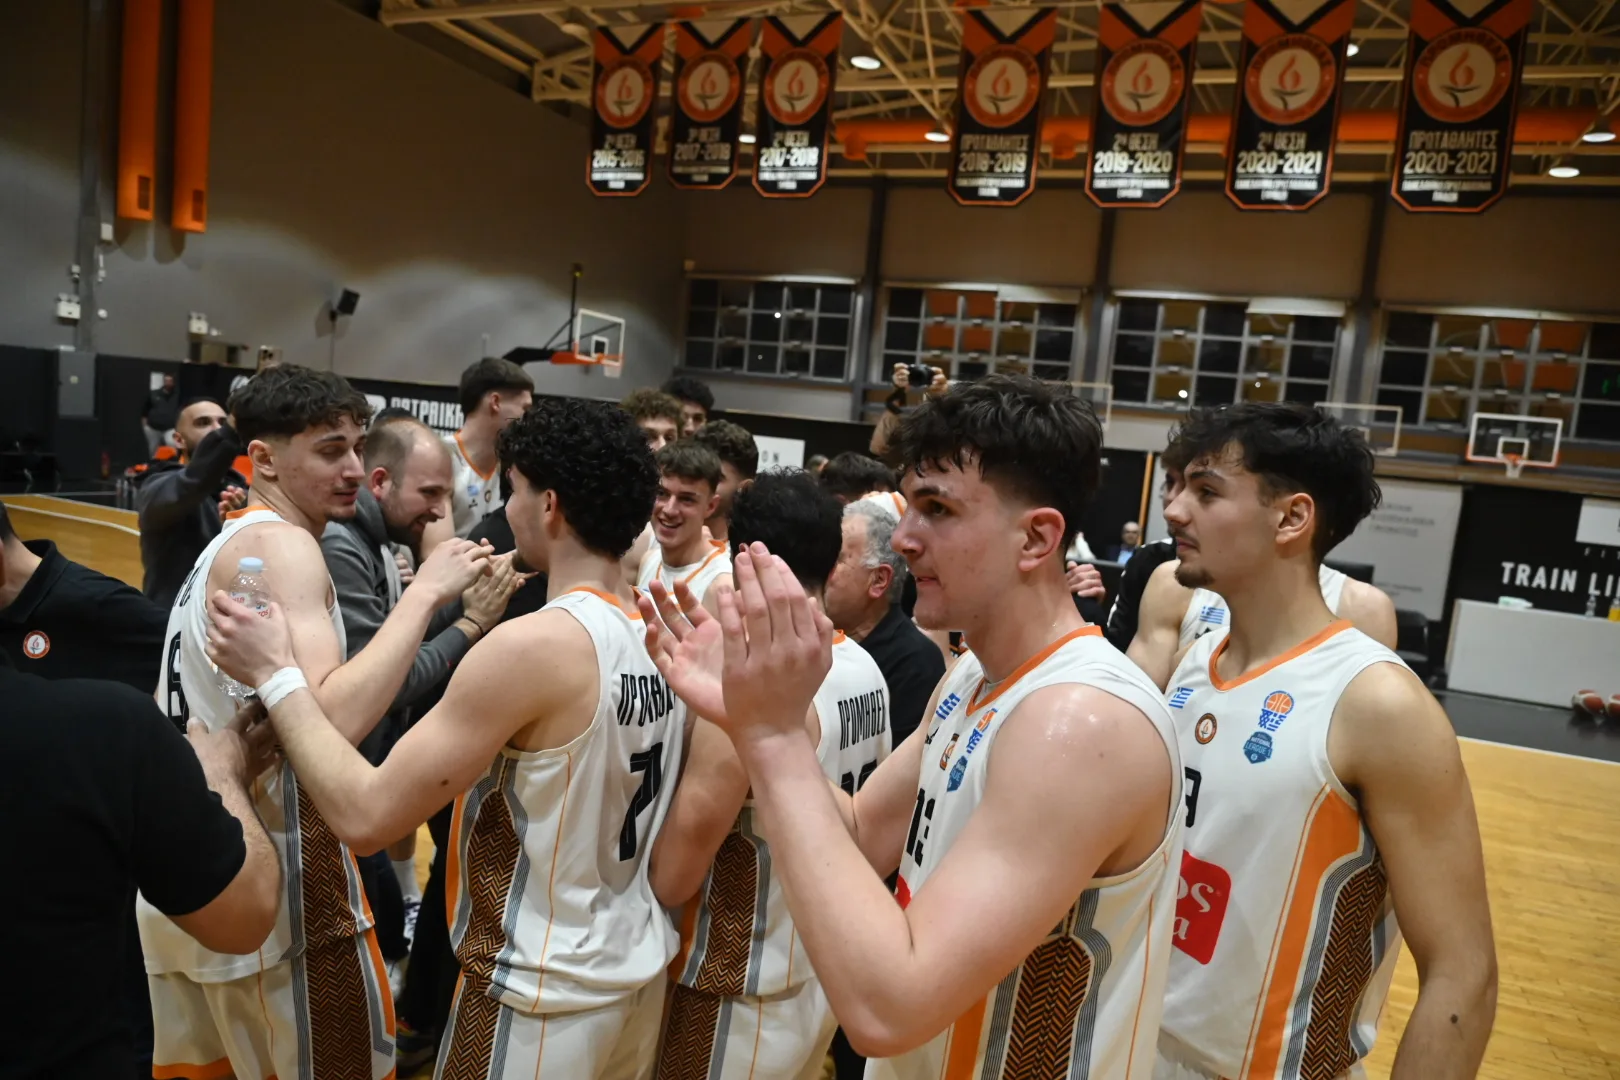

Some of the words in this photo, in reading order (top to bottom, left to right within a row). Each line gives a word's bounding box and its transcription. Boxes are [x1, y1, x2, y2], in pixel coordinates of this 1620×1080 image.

[1408, 130, 1499, 150] ΠΡΩΤΑΘΛΗΤΕΣ
[958, 152, 1027, 173] 2018-2019
[1094, 150, 1173, 173] 2019-2020
[1236, 151, 1323, 174] 2020-2021
[1402, 150, 1497, 174] 2020-2021
[1501, 561, 1578, 593] TRAIN
[1244, 741, 1268, 755] LEAGUE
[619, 741, 663, 862] 7
